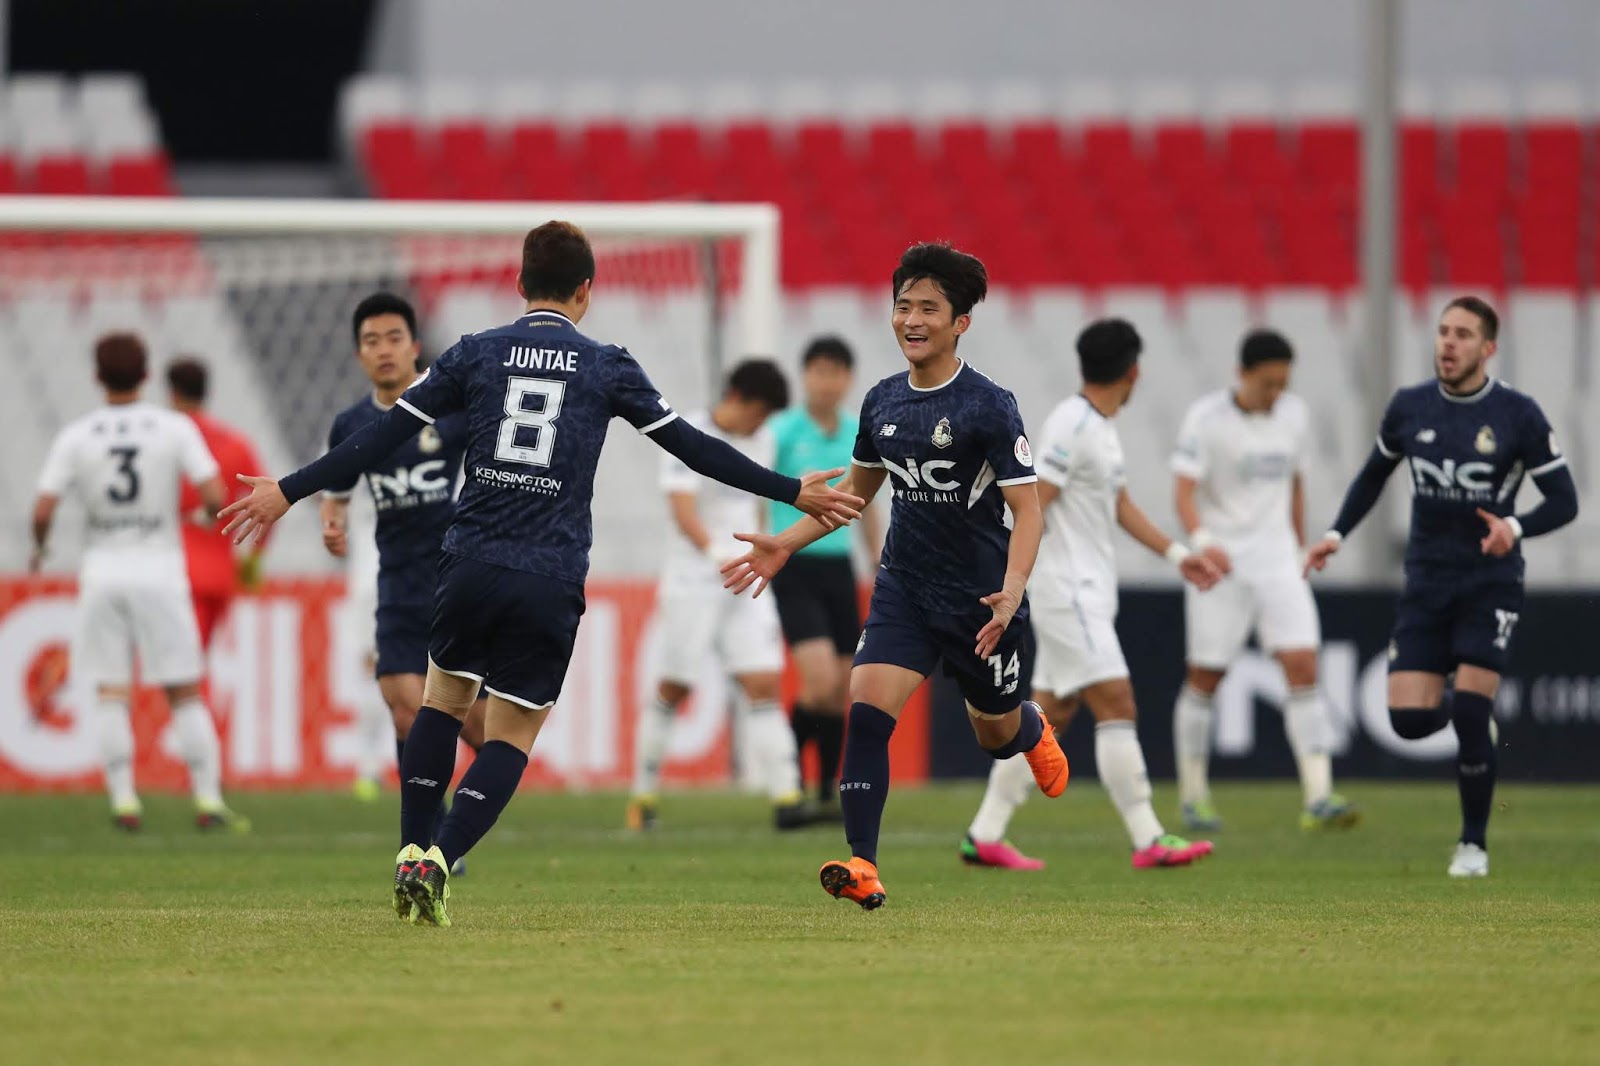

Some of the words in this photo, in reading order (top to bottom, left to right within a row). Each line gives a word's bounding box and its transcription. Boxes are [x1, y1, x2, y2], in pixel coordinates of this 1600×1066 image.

[503, 346, 579, 372] JUNTAE
[493, 375, 567, 468] 8
[108, 446, 140, 505] 3
[369, 459, 450, 500] NC
[475, 466, 562, 491] KENSINGTON
[880, 456, 962, 492] NC
[1411, 456, 1495, 490] NC
[906, 490, 929, 503] CORE
[934, 491, 961, 503] MALL
[987, 649, 1021, 687] 14
